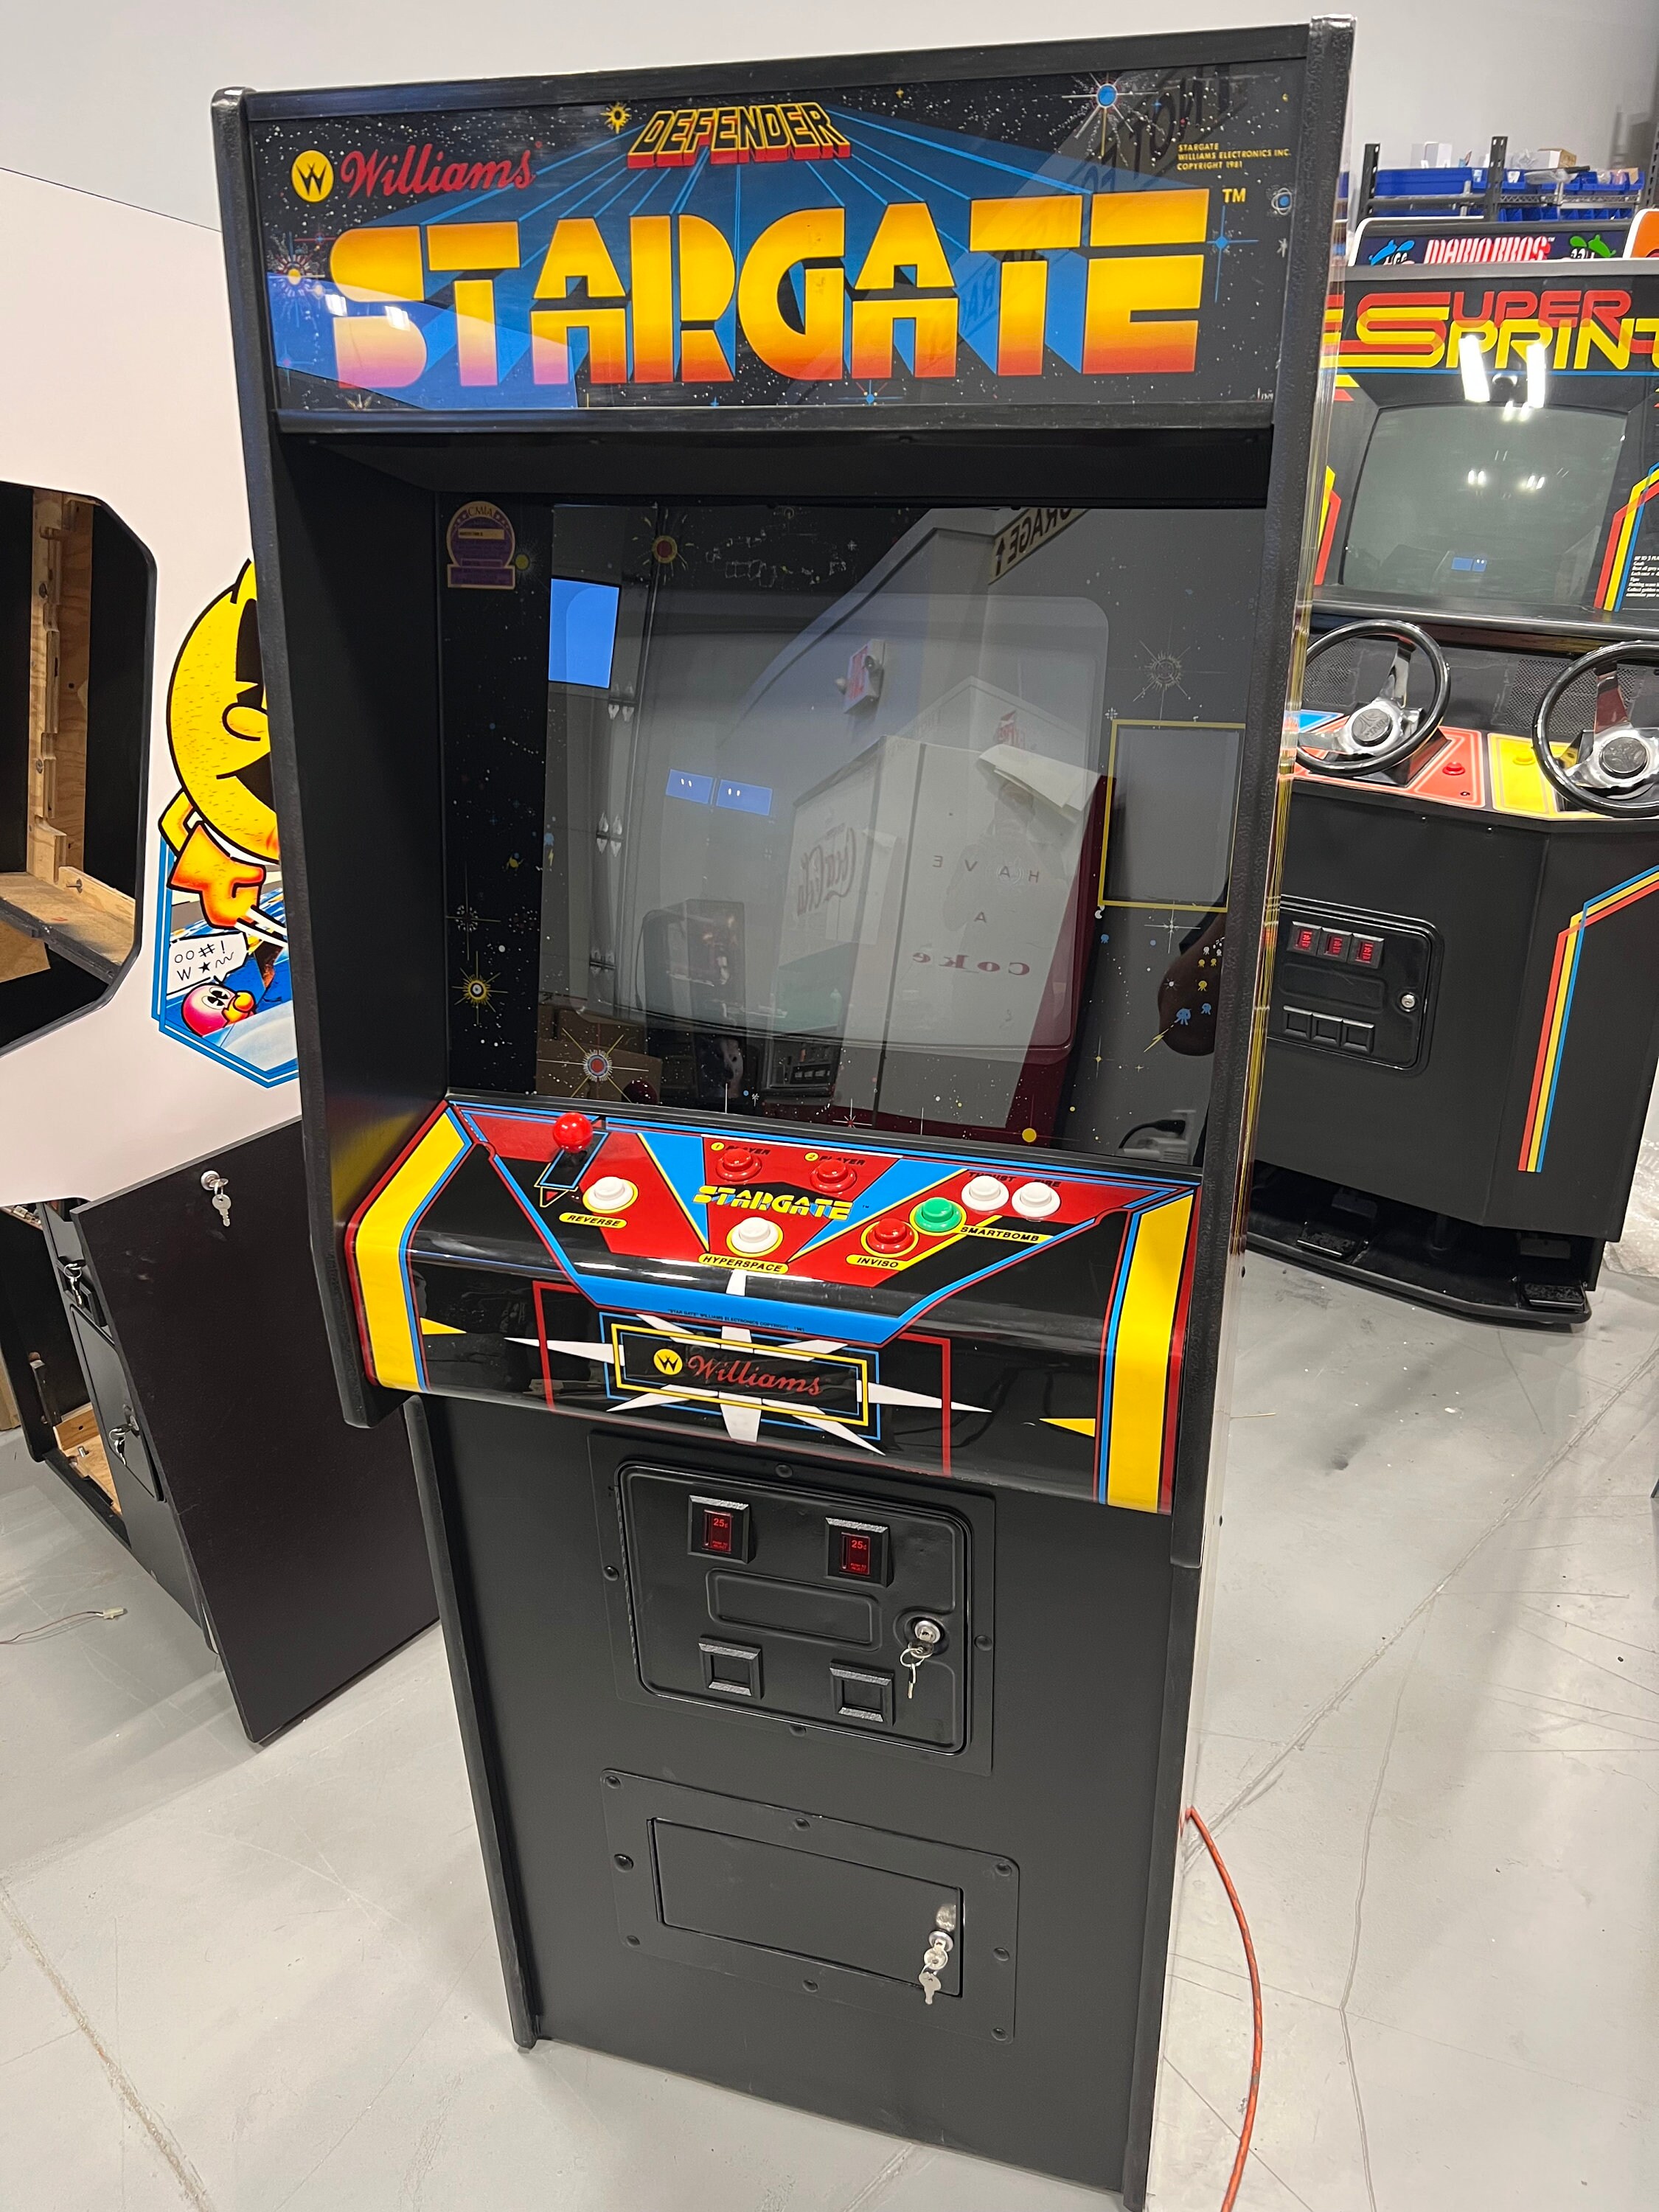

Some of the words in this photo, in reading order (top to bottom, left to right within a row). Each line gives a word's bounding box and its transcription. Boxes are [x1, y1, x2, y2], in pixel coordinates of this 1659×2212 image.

[627, 102, 851, 170] DEFENDER
[1178, 143, 1219, 152] STARGATE
[1178, 152, 1217, 161] WILLIAMS
[1219, 150, 1272, 159] ELECTRONICS
[340, 144, 536, 198] Williams
[1177, 161, 1222, 170] COPYRIGHT
[1225, 160, 1242, 169] 1981
[329, 188, 1210, 389] STARGATE
[1222, 188, 1247, 204] TM
[1355, 289, 1633, 352] SUPER
[692, 1185, 854, 1221] STARGATE
[567, 1214, 621, 1228] REVERSE
[960, 1226, 1039, 1242] SMARTBOMB
[703, 1256, 782, 1273] HYPERSPACE
[857, 1256, 899, 1269] INVISO
[687, 1355, 822, 1396] Williams
